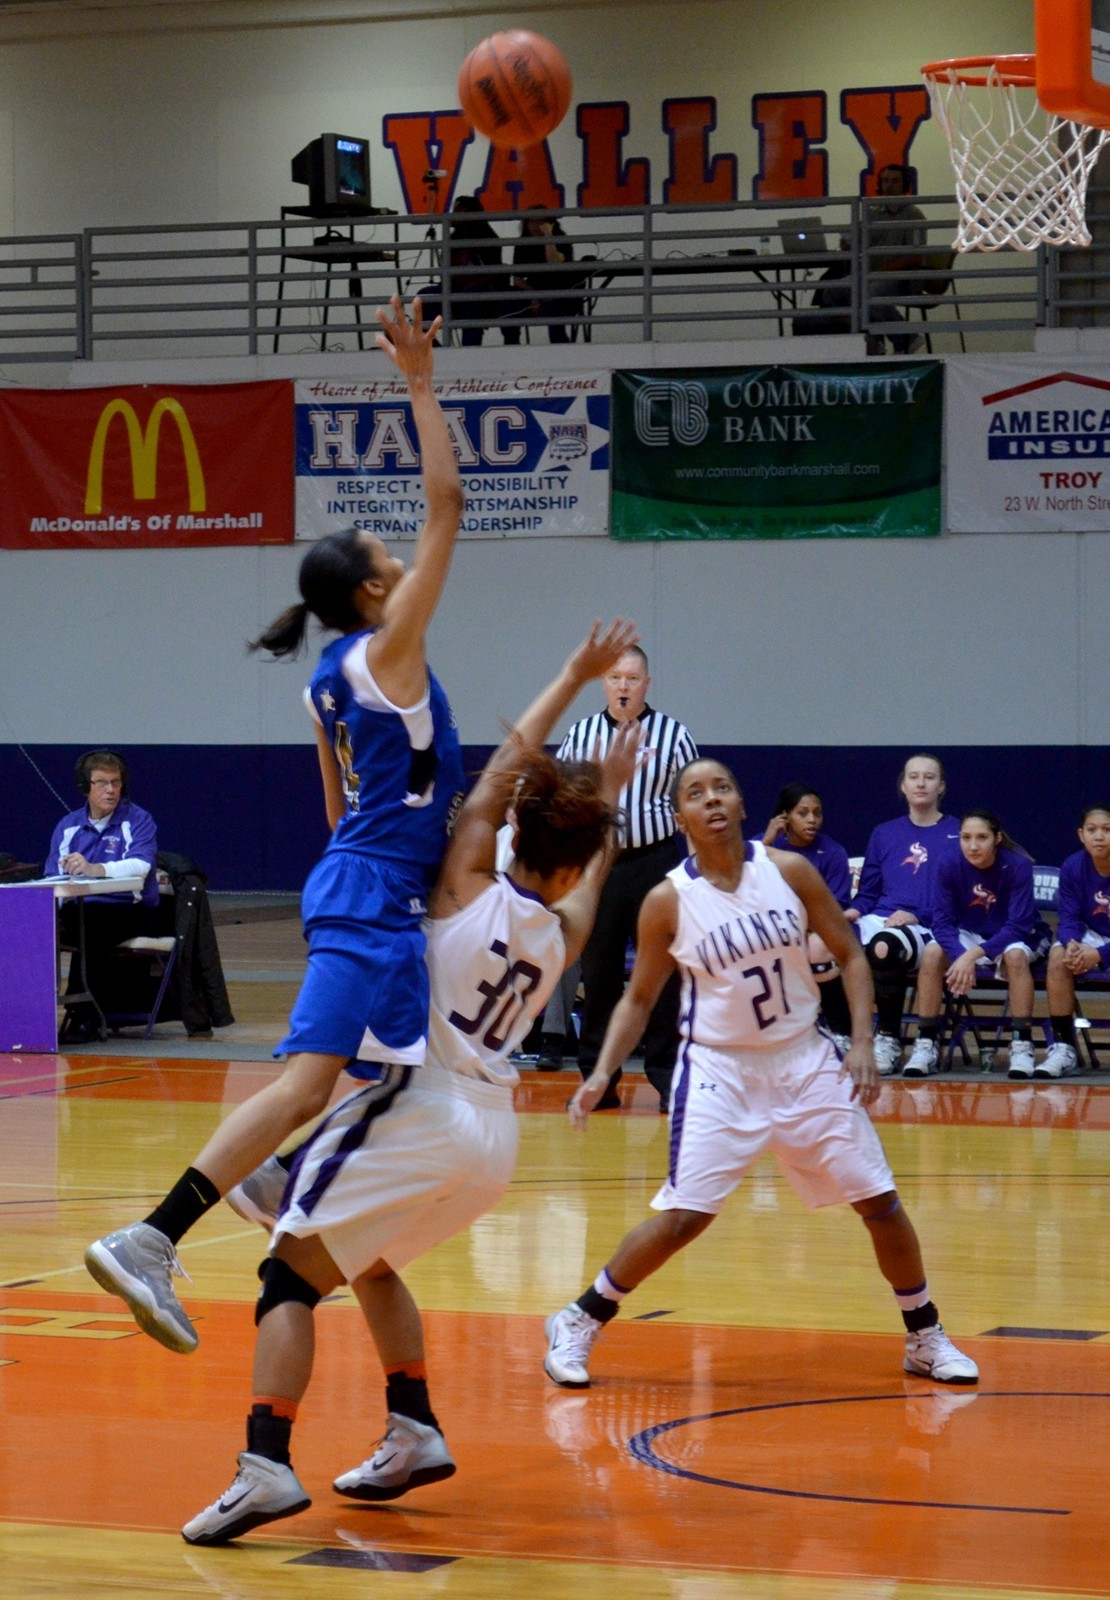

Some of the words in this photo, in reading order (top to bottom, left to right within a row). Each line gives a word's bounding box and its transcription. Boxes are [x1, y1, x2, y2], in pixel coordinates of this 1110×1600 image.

[383, 84, 932, 214] VALLEY
[309, 382, 358, 396] Heart
[362, 383, 378, 400] of
[445, 377, 508, 397] Athletic
[514, 376, 598, 396] Conference
[723, 377, 920, 409] COMMUNITY
[723, 414, 816, 443] BANK
[988, 409, 1110, 434] AMERICA
[675, 463, 880, 480] www.communitybankmarshall.com
[1040, 472, 1103, 489] TROY
[337, 480, 411, 494] RESPECT
[460, 475, 569, 492] PONSIBILITY
[327, 500, 418, 514] INTEGRITY
[465, 495, 579, 512] RTSMANSHIP
[1005, 497, 1021, 512] 23
[1046, 496, 1083, 511] North
[30, 516, 141, 532] McDonald's
[147, 515, 171, 531] Of
[176, 513, 263, 530] Marshall
[354, 519, 422, 533] SERVAN
[460, 516, 543, 532] ADERSHIP
[696, 909, 803, 977] VIKINGS
[448, 939, 542, 1052] 30
[742, 958, 791, 1030] 21
